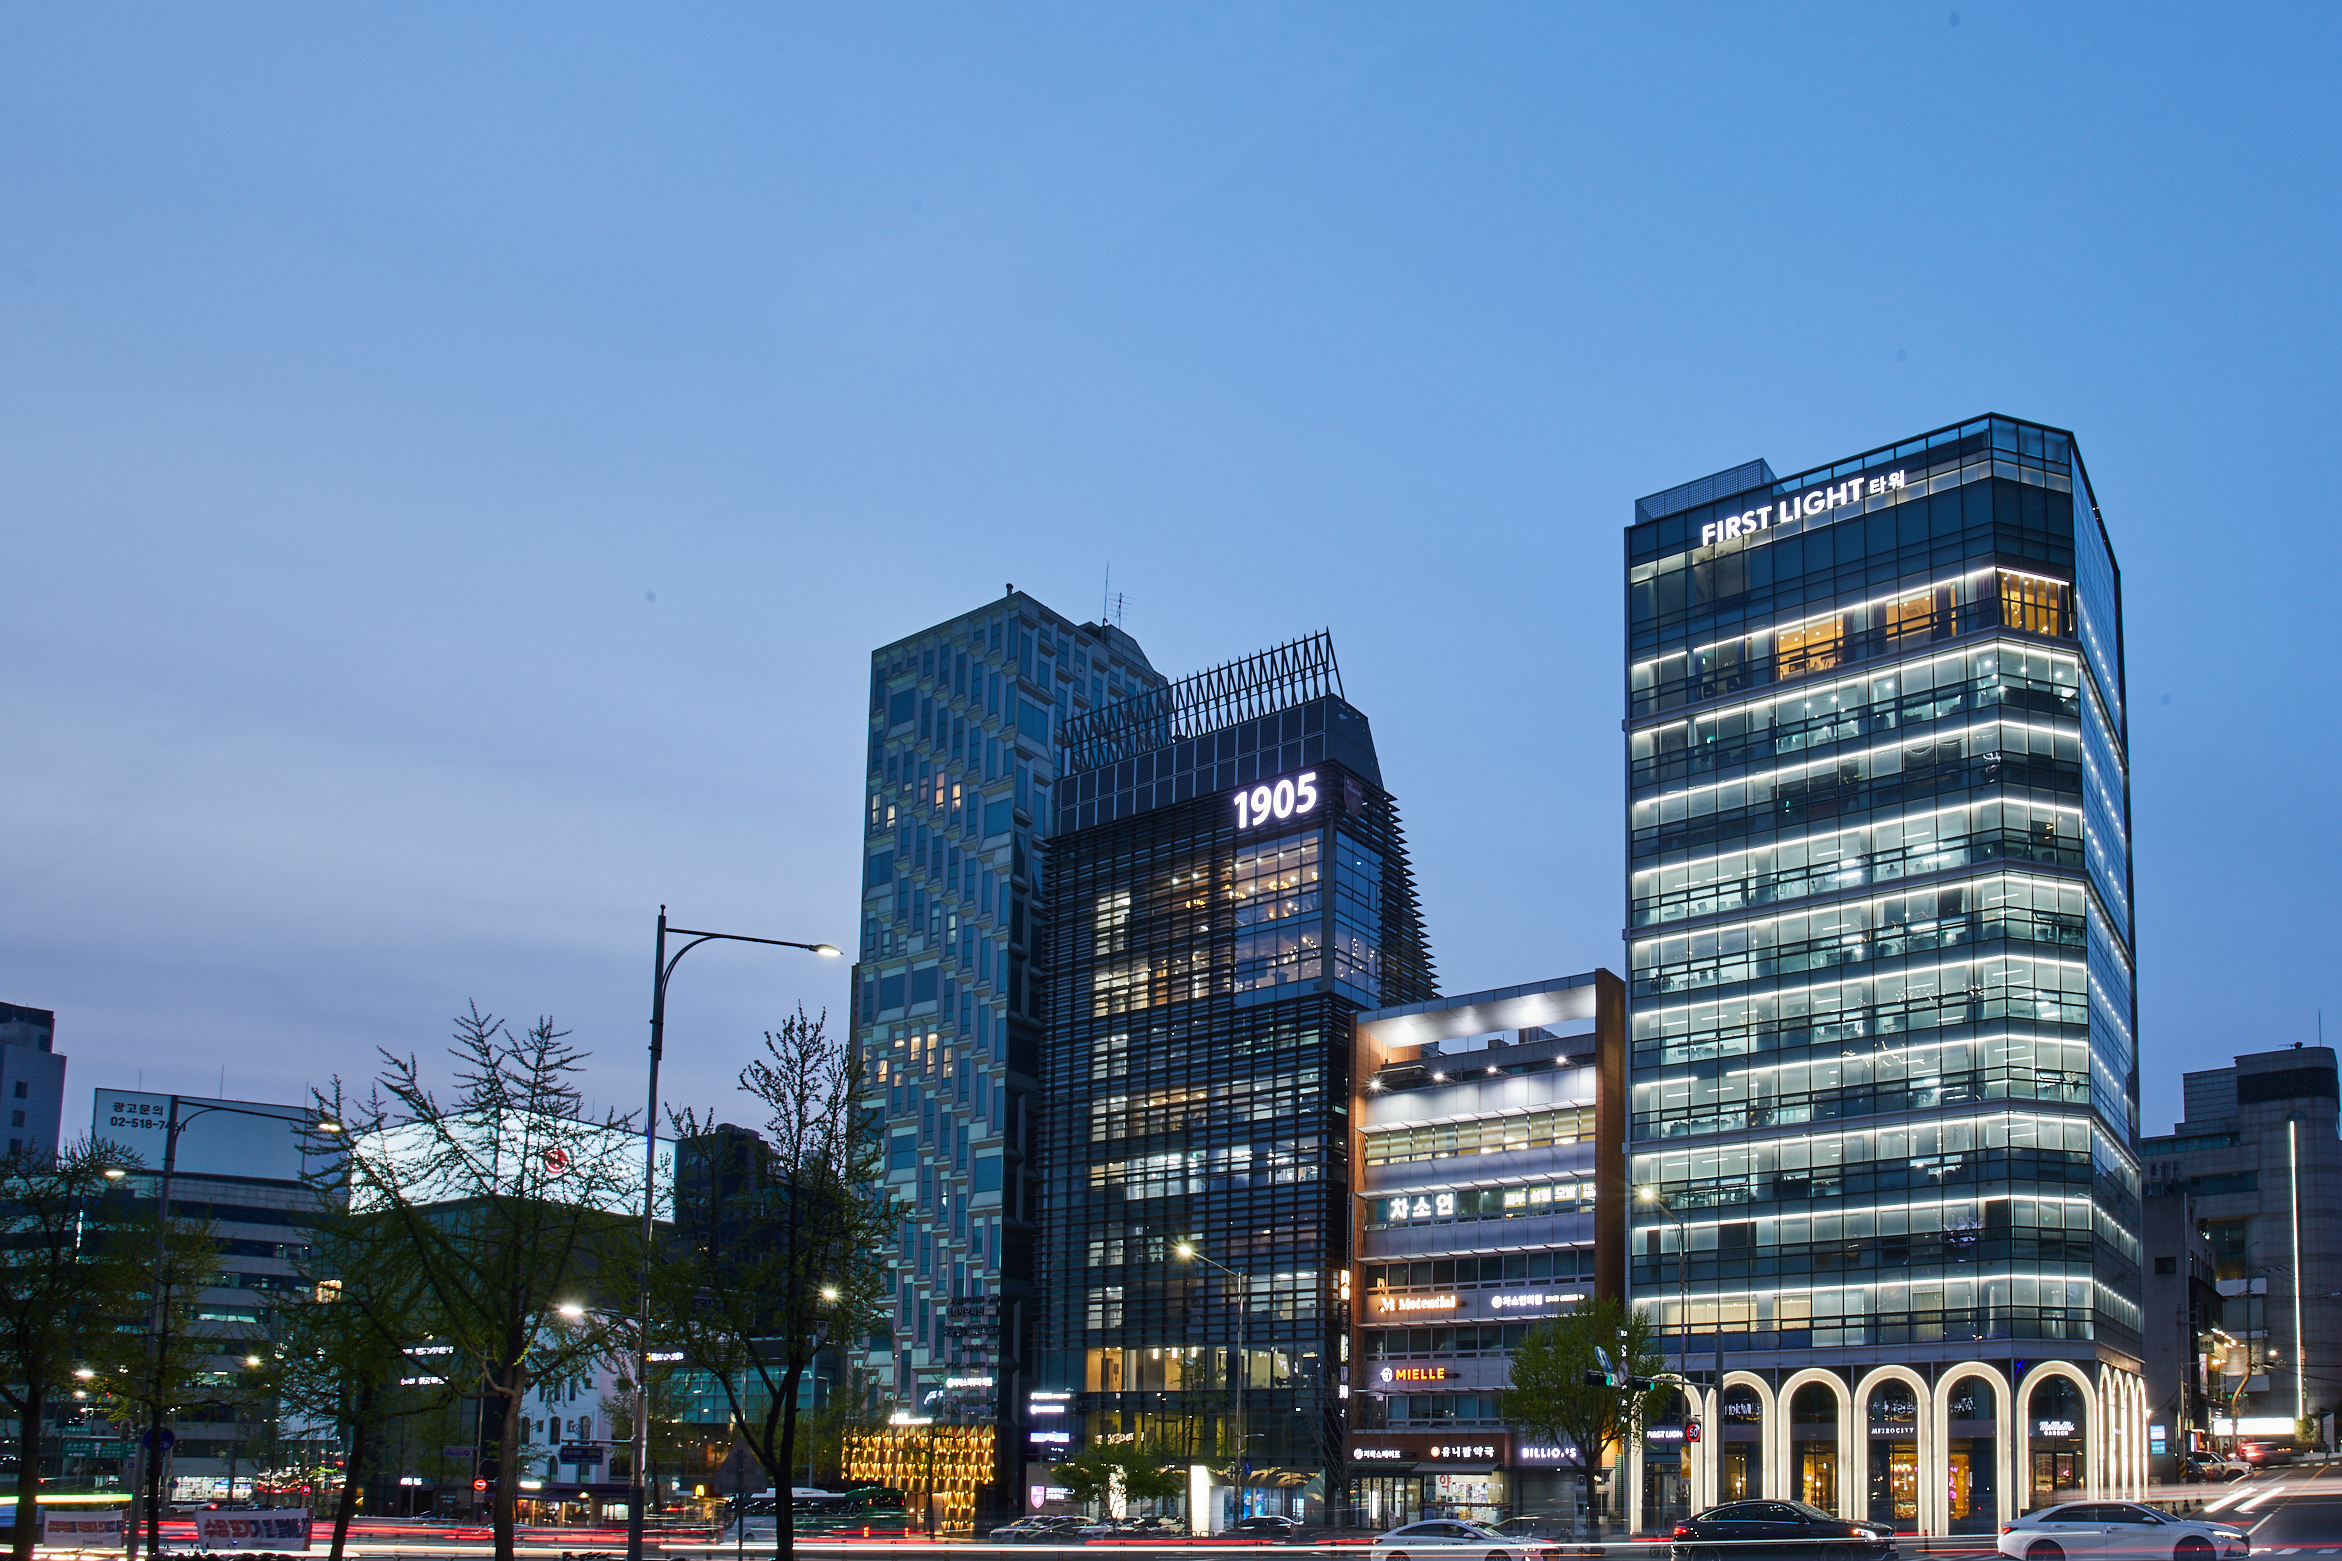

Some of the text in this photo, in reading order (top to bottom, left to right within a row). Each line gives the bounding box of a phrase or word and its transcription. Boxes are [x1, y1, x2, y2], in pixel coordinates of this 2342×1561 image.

[1702, 470, 1905, 547] FIRST LIGHT 타워
[1233, 771, 1317, 829] 1905
[113, 1102, 163, 1116] 광고문의
[1505, 1193, 1526, 1205] 피부
[1530, 1189, 1551, 1202] 성형
[1555, 1185, 1577, 1199] 모발
[1390, 1193, 1454, 1219] 차소연
[1395, 1367, 1445, 1381] MIELLE
[1665, 1430, 1683, 1438] LIGH
[1689, 1428, 1699, 1437] 50
[1871, 1426, 1914, 1435] METROCITY
[1441, 1445, 1495, 1458] 유니팜약국
[1439, 1475, 1451, 1492] 약
